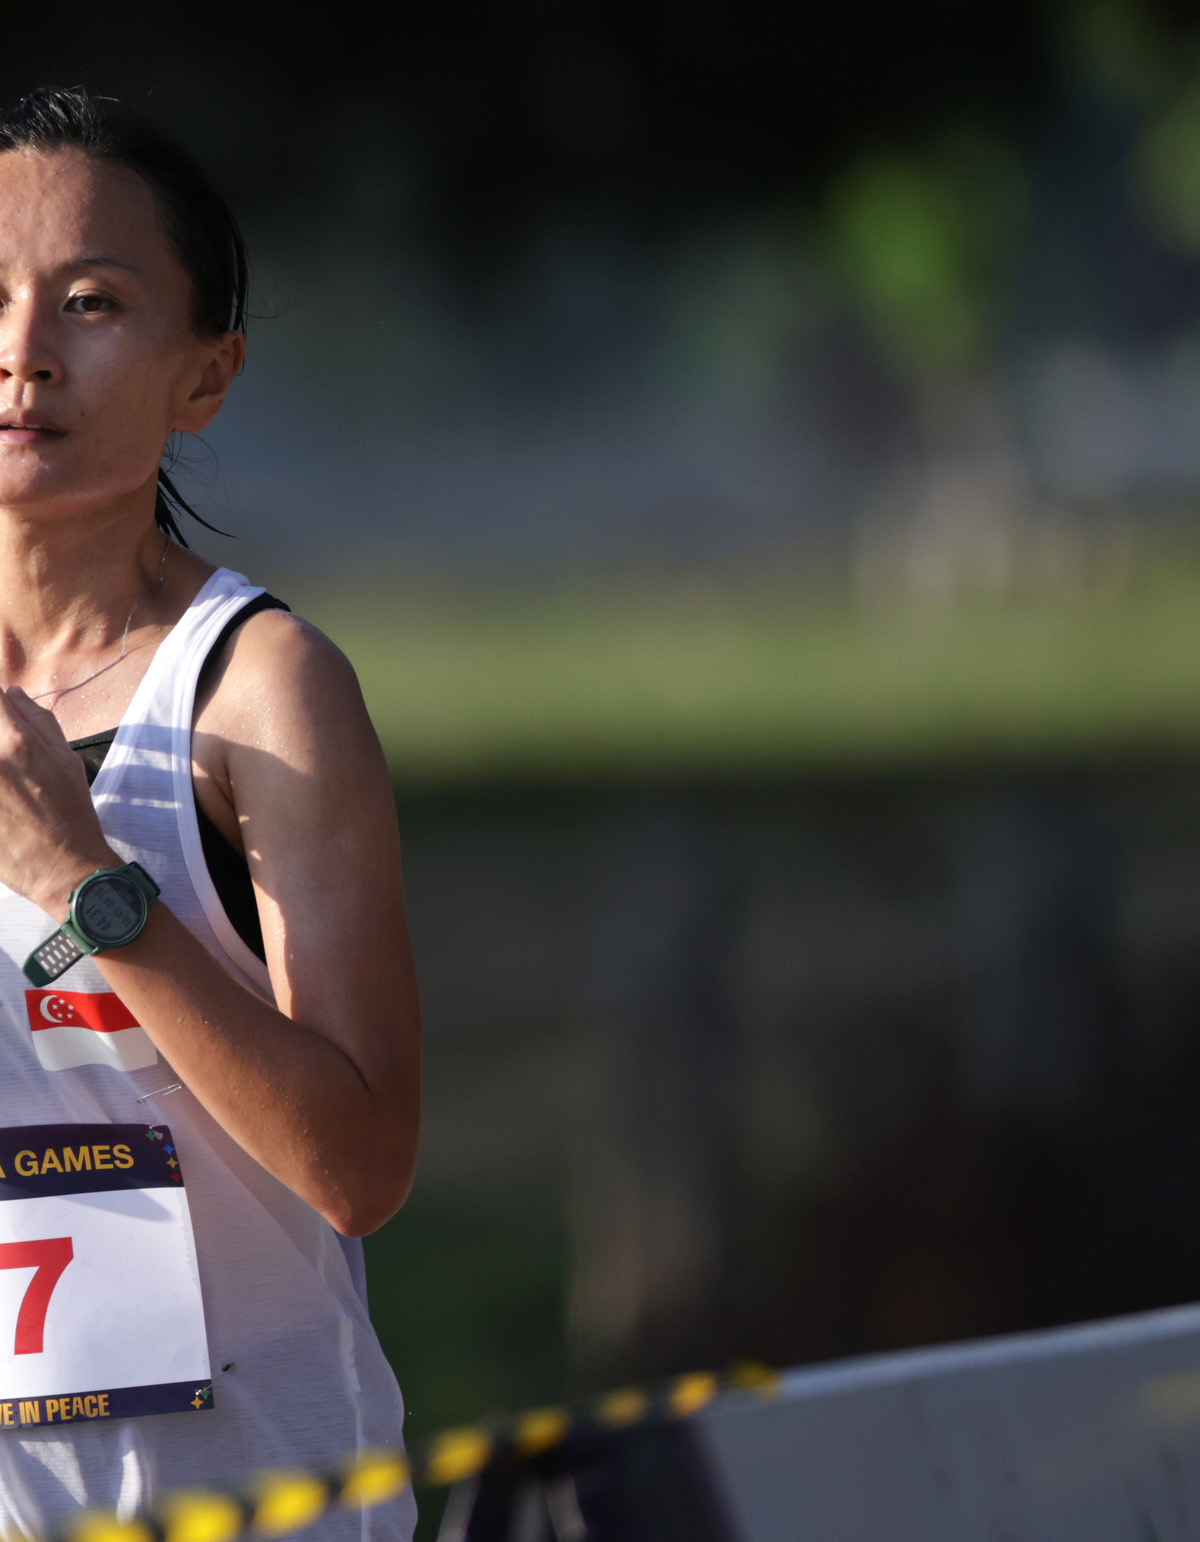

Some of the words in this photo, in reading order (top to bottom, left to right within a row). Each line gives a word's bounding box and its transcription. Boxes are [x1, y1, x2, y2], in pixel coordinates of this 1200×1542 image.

[14, 1144, 134, 1177] GAMES
[19, 1400, 40, 1424] IN
[45, 1394, 110, 1422] PEACE
